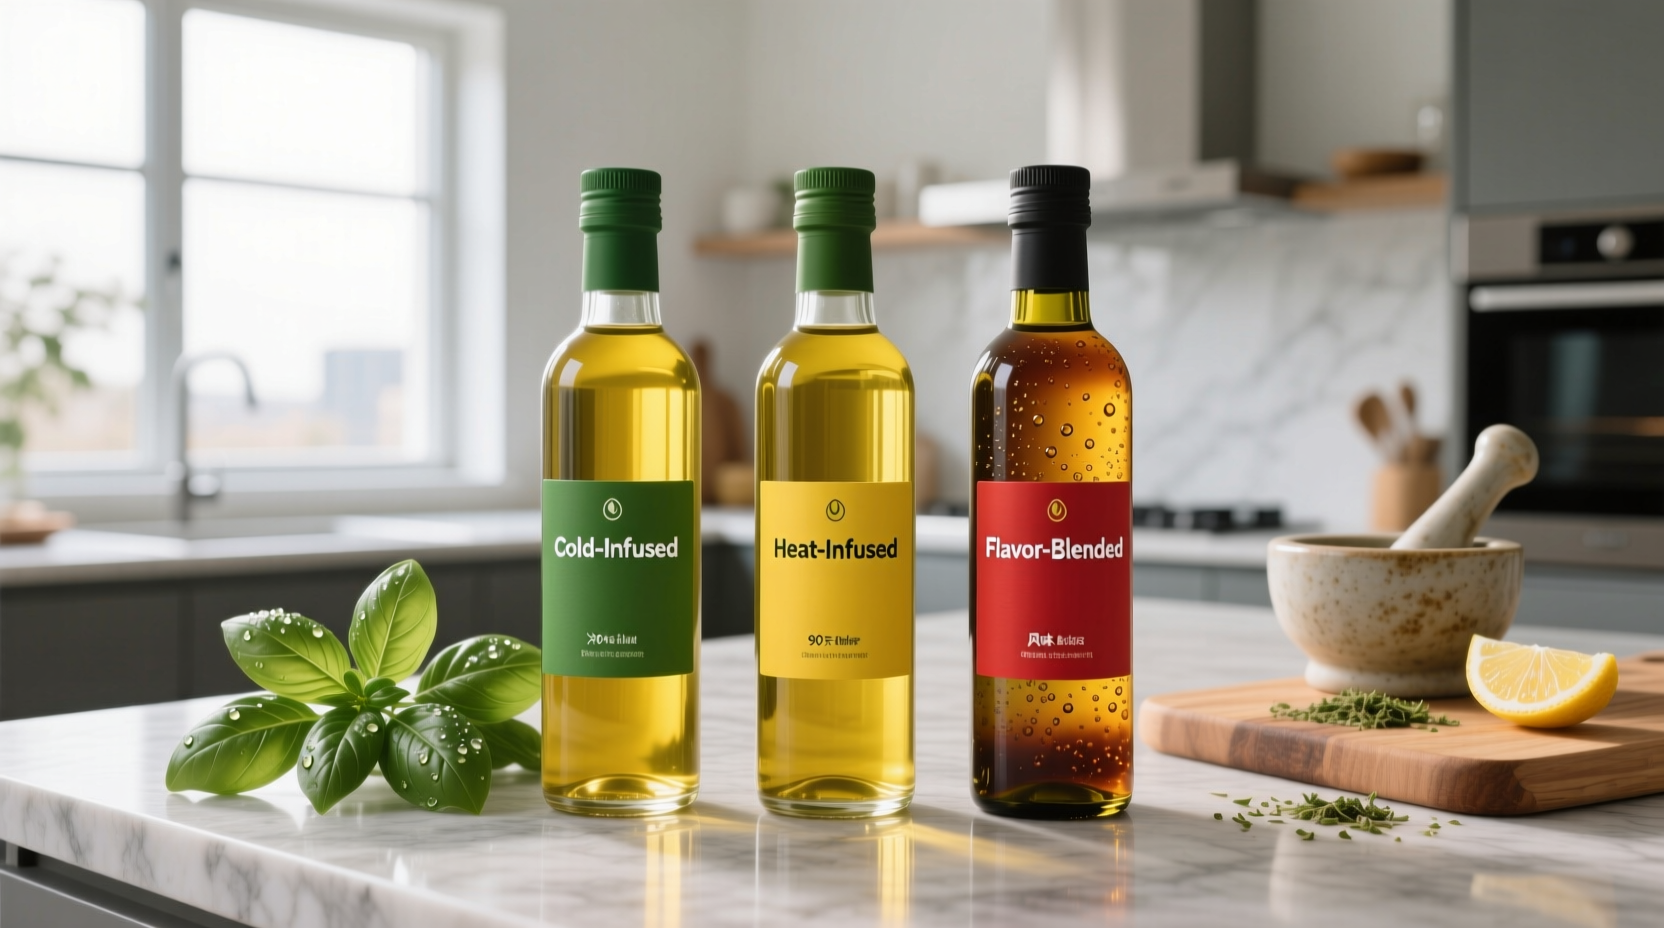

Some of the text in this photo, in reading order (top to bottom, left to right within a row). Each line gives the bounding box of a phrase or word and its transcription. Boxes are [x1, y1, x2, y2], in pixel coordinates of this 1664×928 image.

[554, 535, 679, 559] Cold-Infused
[774, 536, 898, 560] Heat-Infused
[985, 536, 1123, 560] Flavor-Blended
